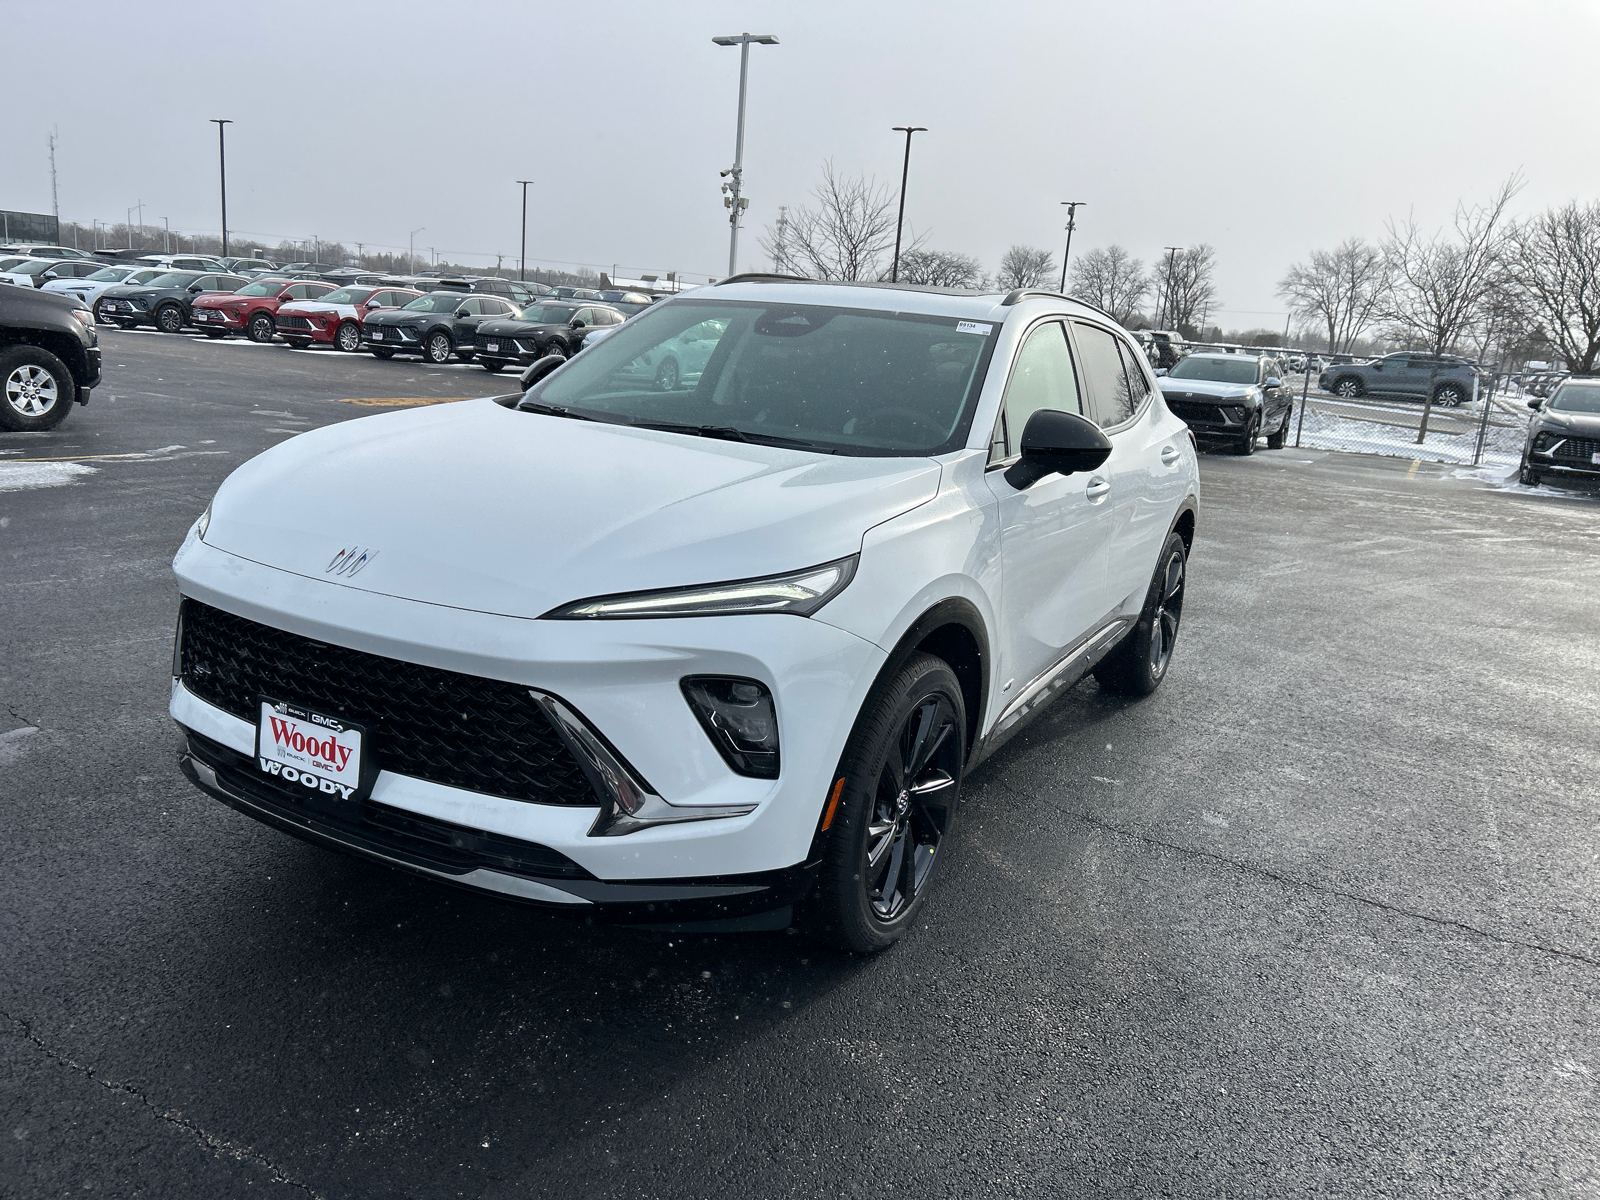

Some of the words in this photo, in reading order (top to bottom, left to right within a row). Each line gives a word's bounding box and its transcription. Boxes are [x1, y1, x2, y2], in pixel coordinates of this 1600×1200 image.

[288, 708, 305, 717] BUICK
[311, 714, 338, 728] GMC
[269, 716, 353, 772] Woody
[287, 752, 305, 762] BUICK
[312, 761, 334, 772] GMC
[259, 758, 354, 800] WOODY
